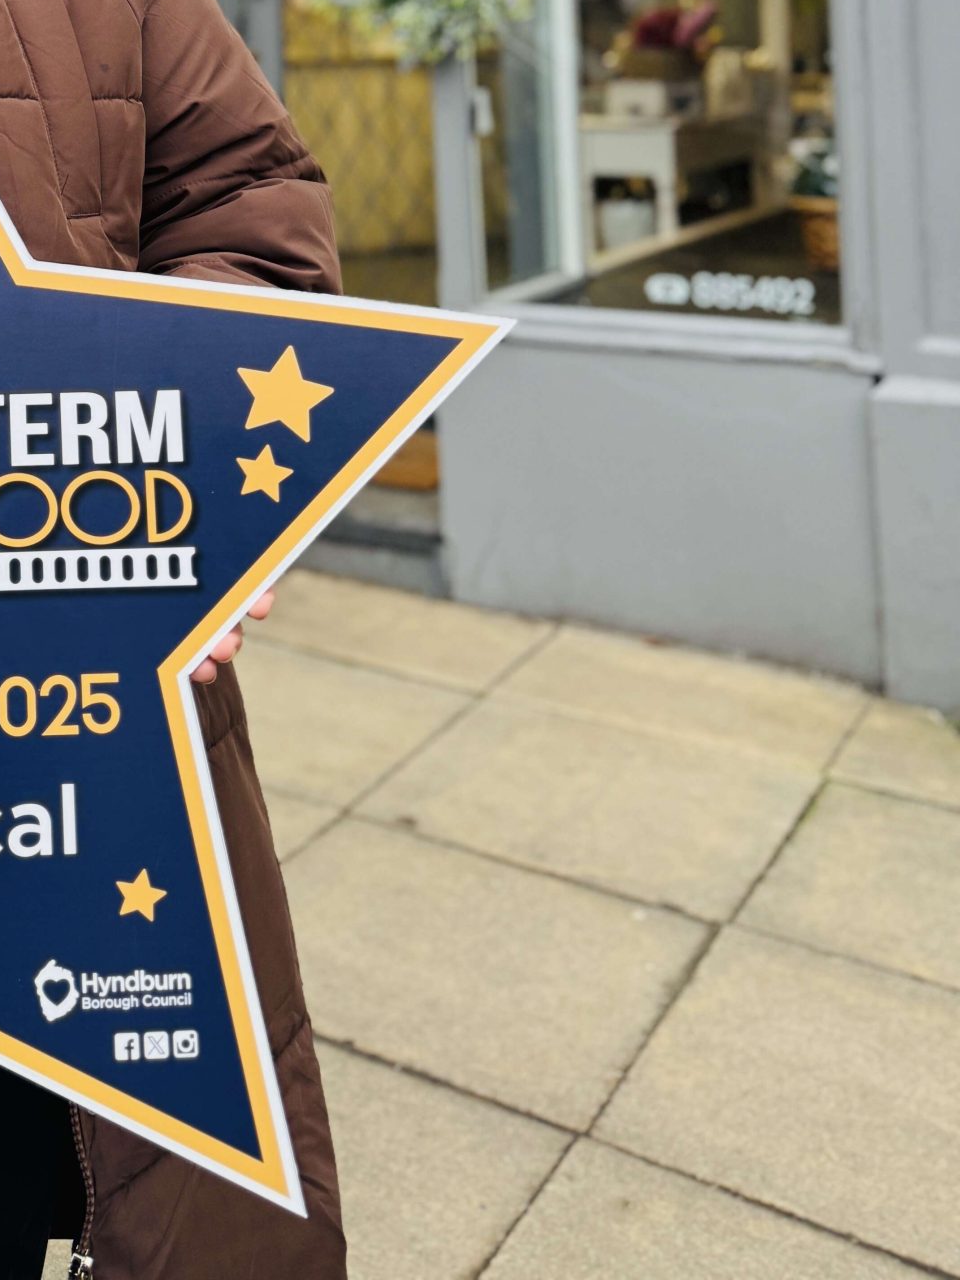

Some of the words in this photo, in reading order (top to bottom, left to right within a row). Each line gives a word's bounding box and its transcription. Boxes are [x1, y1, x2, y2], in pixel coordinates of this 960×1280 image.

[81, 969, 192, 997] Hyndburn
[81, 995, 139, 1011] Borough
[142, 992, 192, 1008] Council
